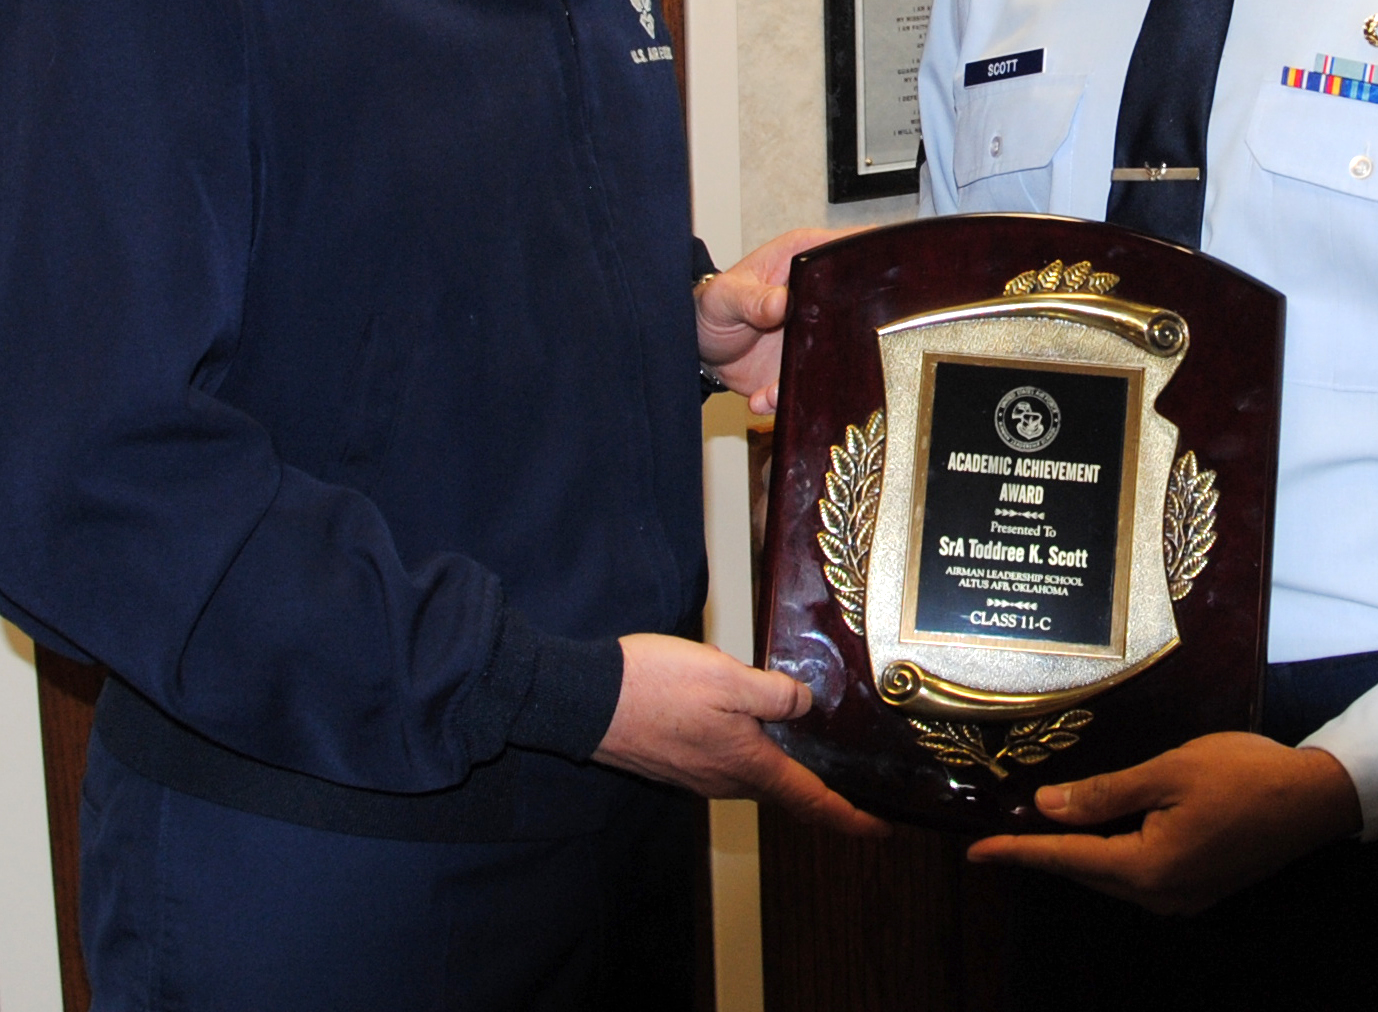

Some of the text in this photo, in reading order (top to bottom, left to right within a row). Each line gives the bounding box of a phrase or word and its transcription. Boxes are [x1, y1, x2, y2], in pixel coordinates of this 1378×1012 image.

[987, 58, 1019, 77] SCOTT
[947, 451, 1101, 484] ACADEMIC ACHIEVEMENT
[998, 482, 1044, 505] AWARD
[990, 520, 1057, 538] Presented To
[938, 535, 1089, 568] SrA Toddree K. Scott
[945, 566, 1084, 587] AIRMAN LEADERSHIP SCHOOL
[958, 578, 1069, 597] ALTUS AFB, OKLAHOMA
[969, 610, 1052, 631] CLASS 11-C
